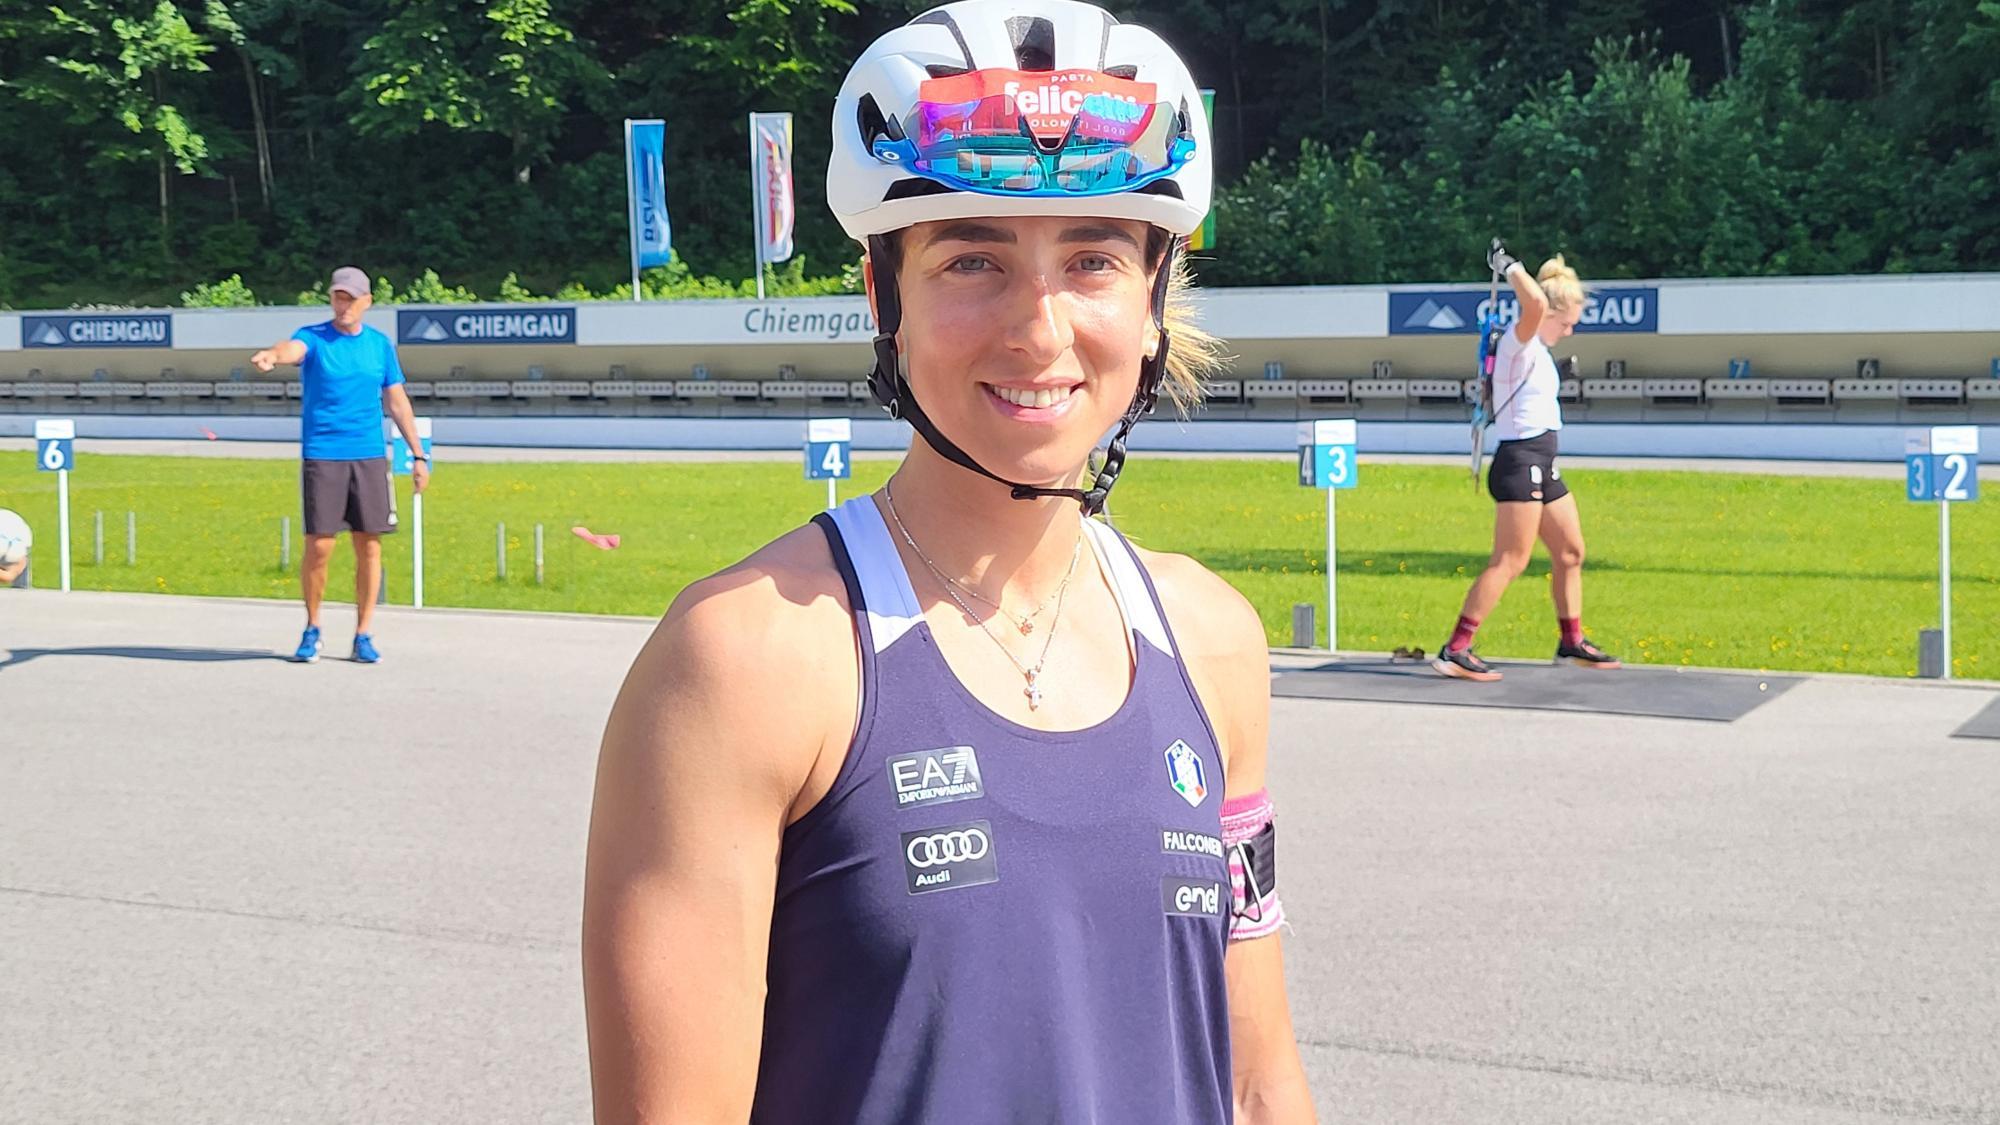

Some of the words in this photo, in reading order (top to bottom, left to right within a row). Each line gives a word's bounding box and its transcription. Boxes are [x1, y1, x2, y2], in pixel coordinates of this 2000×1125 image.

[1051, 73, 1094, 83] PASTA
[1476, 297, 1644, 325] CHGAU
[68, 320, 166, 342] CHIEMGAU
[454, 314, 569, 338] CHIEMGAU
[1266, 362, 1282, 380] 11
[1375, 361, 1391, 379] 10
[1609, 361, 1623, 379] 8
[1734, 360, 1746, 379] 7
[1862, 359, 1875, 379] 6
[43, 439, 65, 470] 6
[822, 442, 844, 477] 4
[1301, 446, 1313, 485] 4
[1327, 446, 1347, 483] 3
[1911, 458, 1925, 498] 3
[1943, 453, 1968, 500] 2
[892, 752, 969, 792] EA7
[915, 869, 951, 887] Audi
[1175, 883, 1219, 914] enel
